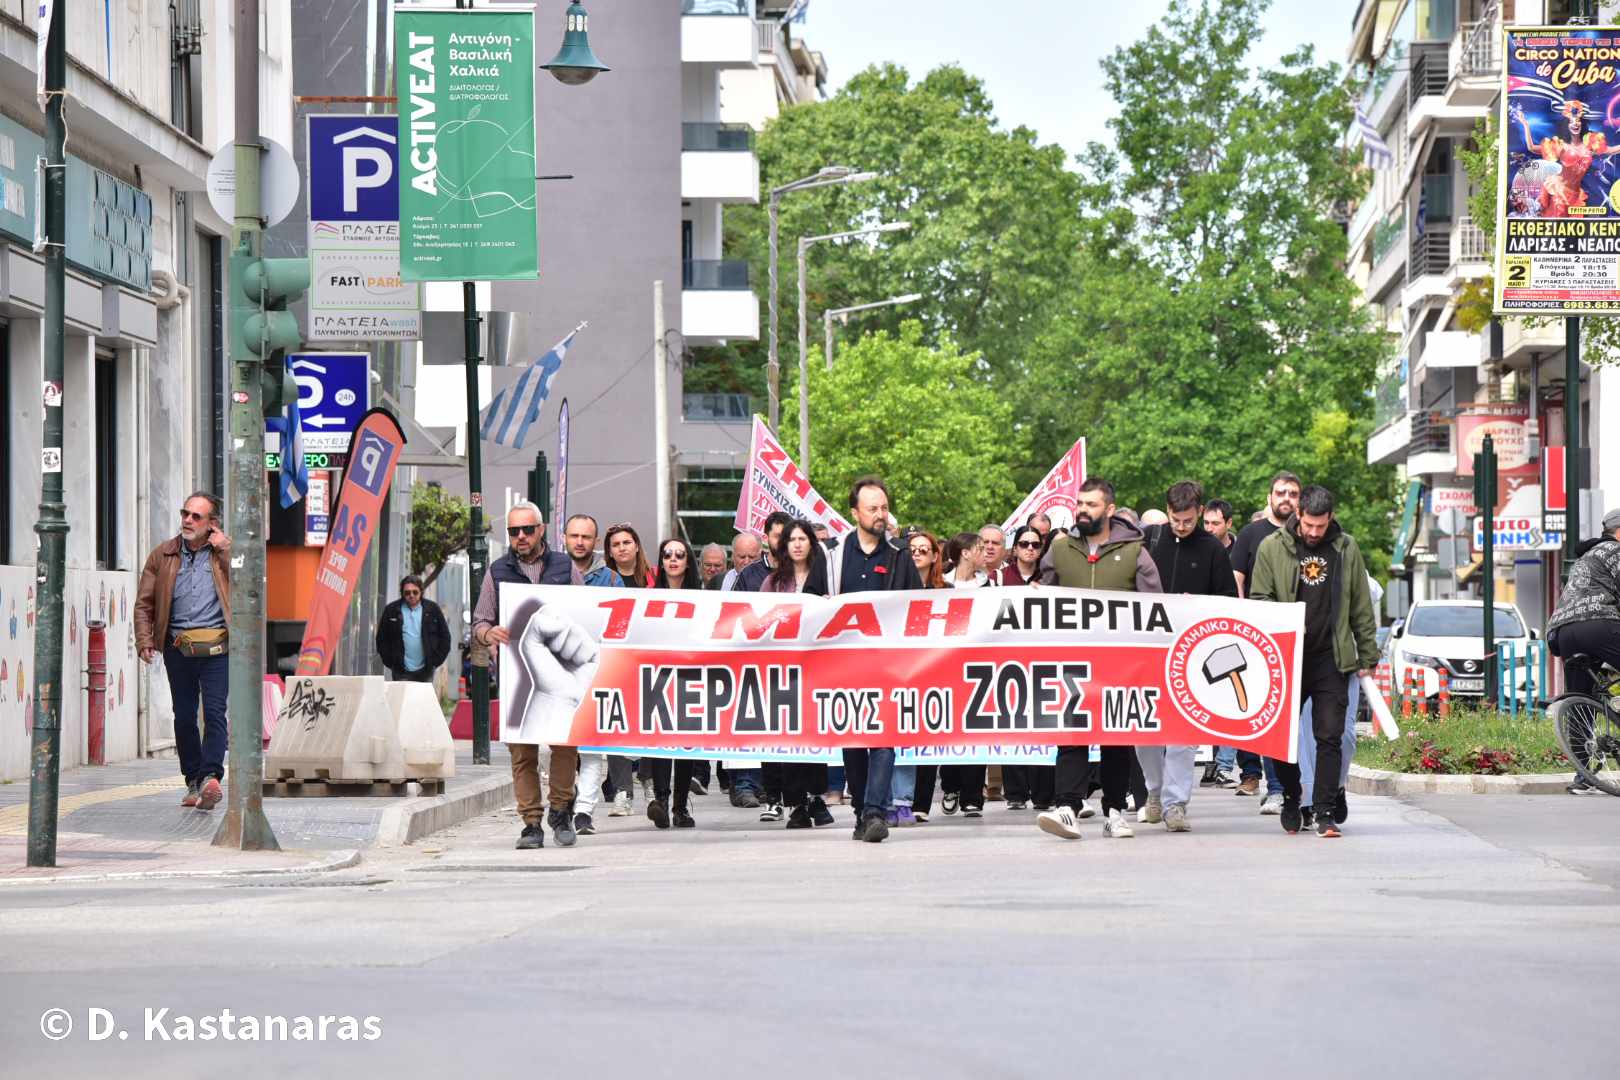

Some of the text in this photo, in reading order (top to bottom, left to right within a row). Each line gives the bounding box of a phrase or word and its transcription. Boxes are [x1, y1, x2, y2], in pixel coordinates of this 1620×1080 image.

[448, 32, 512, 47] Αντιγόνη
[449, 48, 512, 62] Βασιλική
[1514, 48, 1620, 60] CIRCO NATION
[449, 64, 500, 76] Χαλκιά
[1536, 59, 1617, 90] de Cuba
[408, 31, 438, 196] ACTIVEAT
[342, 225, 399, 234] ΠΛΑΤΕ
[1509, 221, 1585, 236] ΕΚΘΕΣΙΑΚΟ
[1508, 238, 1566, 252] ΛΑΡΙΣΑΣ
[1577, 237, 1620, 252] ΝΕΑΠΟ
[1574, 255, 1581, 263] 2
[1509, 265, 1526, 281] 2
[331, 276, 360, 287] FAST
[1563, 301, 1620, 309] 6983.68.2
[315, 329, 418, 337] ΠΛΥΝΤΗΡΙΟ ΑΥΤΟΚΙΝΗΤΩΝ
[993, 598, 1174, 633] ΑΠΕΡΓΙΑ
[1233, 623, 1278, 664] ΚΕΝΤΡΟ
[593, 690, 625, 732] ΤΑ
[641, 666, 800, 732] ΚΕΡΔΗ
[816, 691, 881, 732] ΤΟΥΣ
[924, 691, 951, 731] ΟΙ
[963, 664, 1089, 730] ΖΩΕΣ
[1104, 690, 1159, 729] ΜΑΣ
[1249, 685, 1281, 731] ΛΑΡΙΣΑΣ
